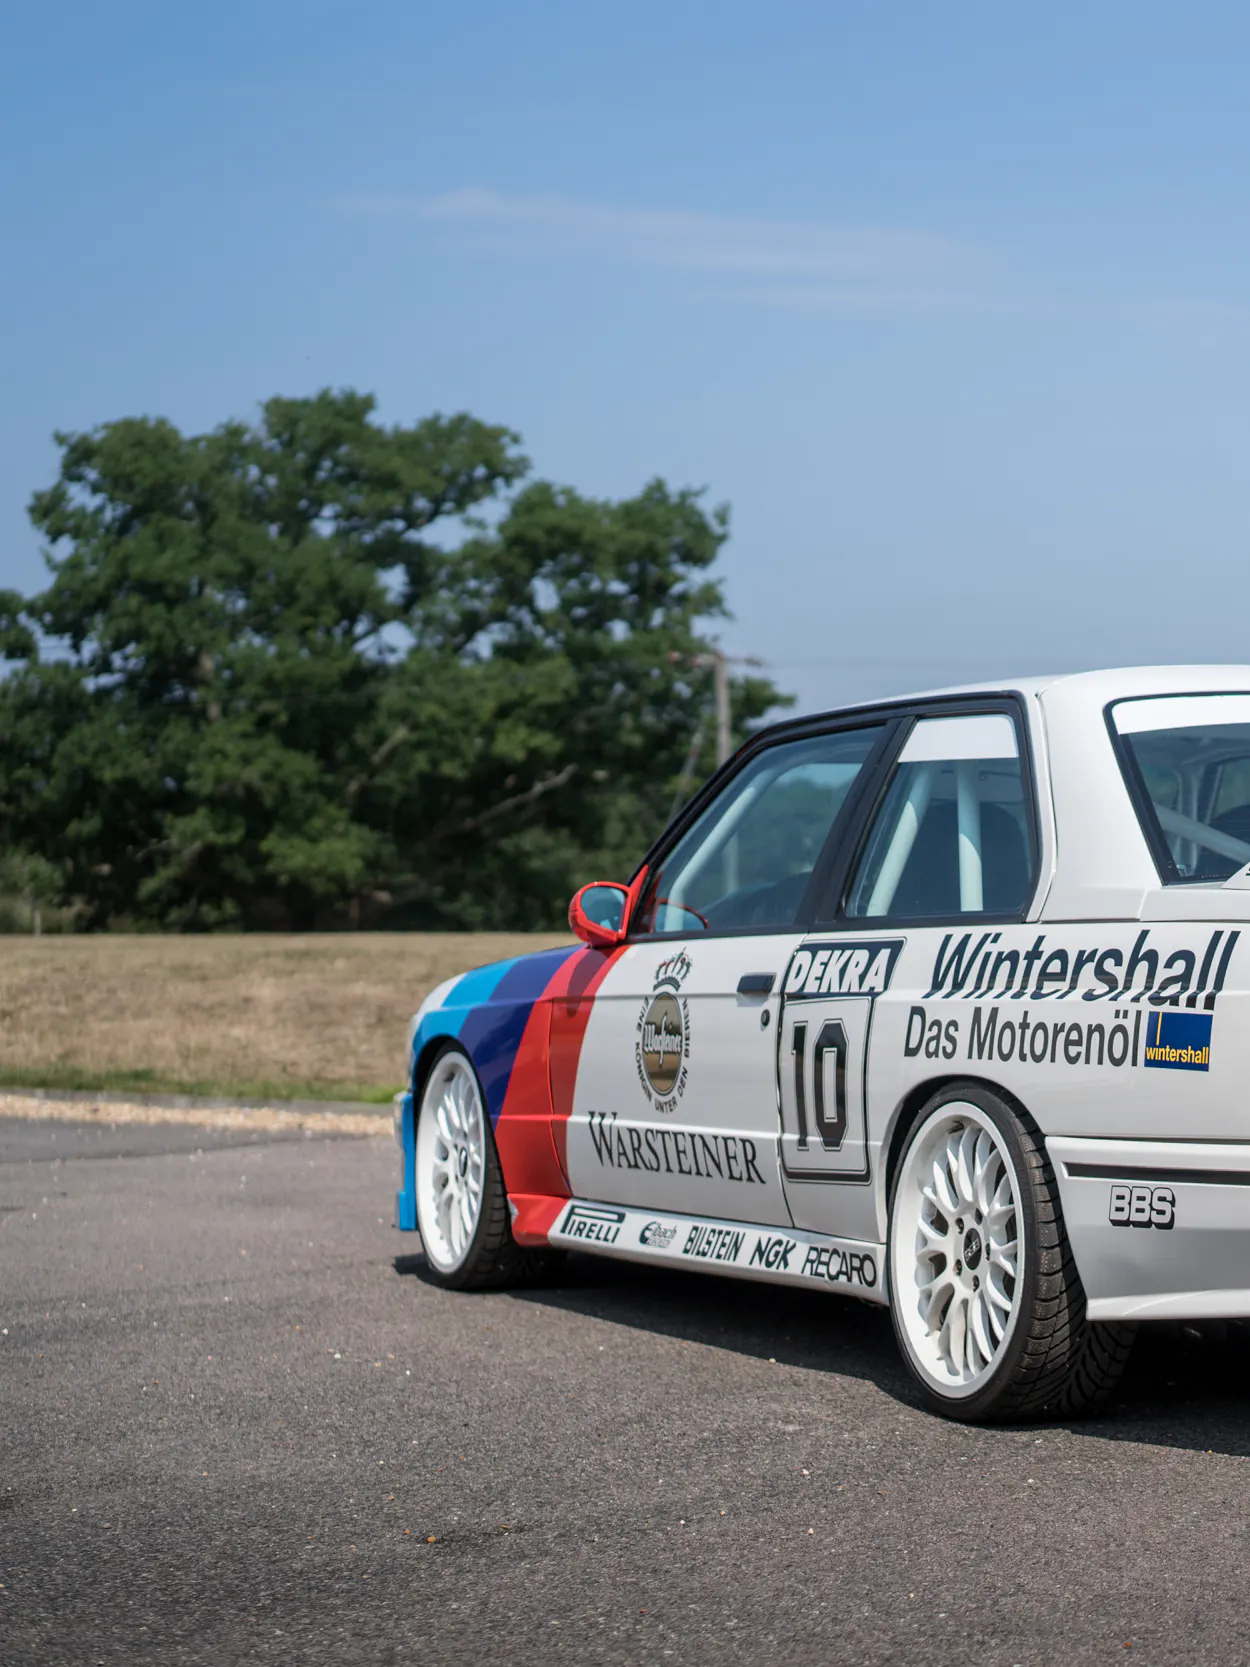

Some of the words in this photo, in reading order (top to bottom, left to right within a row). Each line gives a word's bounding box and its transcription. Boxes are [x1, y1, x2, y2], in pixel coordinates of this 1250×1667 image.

[785, 948, 892, 993] DEKRA
[921, 929, 1241, 1011] Wintershall
[636, 996, 650, 1032] EINE
[654, 1096, 678, 1114] UNTER
[677, 1066, 689, 1098] DEN
[904, 1006, 959, 1059] Das
[967, 1006, 1142, 1068] Motorenöl
[1146, 1045, 1210, 1065] wintershall
[791, 1018, 850, 1152] 10
[560, 1205, 626, 1243] PIRELLI
[1109, 1185, 1176, 1230] BBS
[682, 1225, 746, 1262] BILSTEIN
[749, 1236, 796, 1270] NGK
[801, 1246, 877, 1287] RECARO
